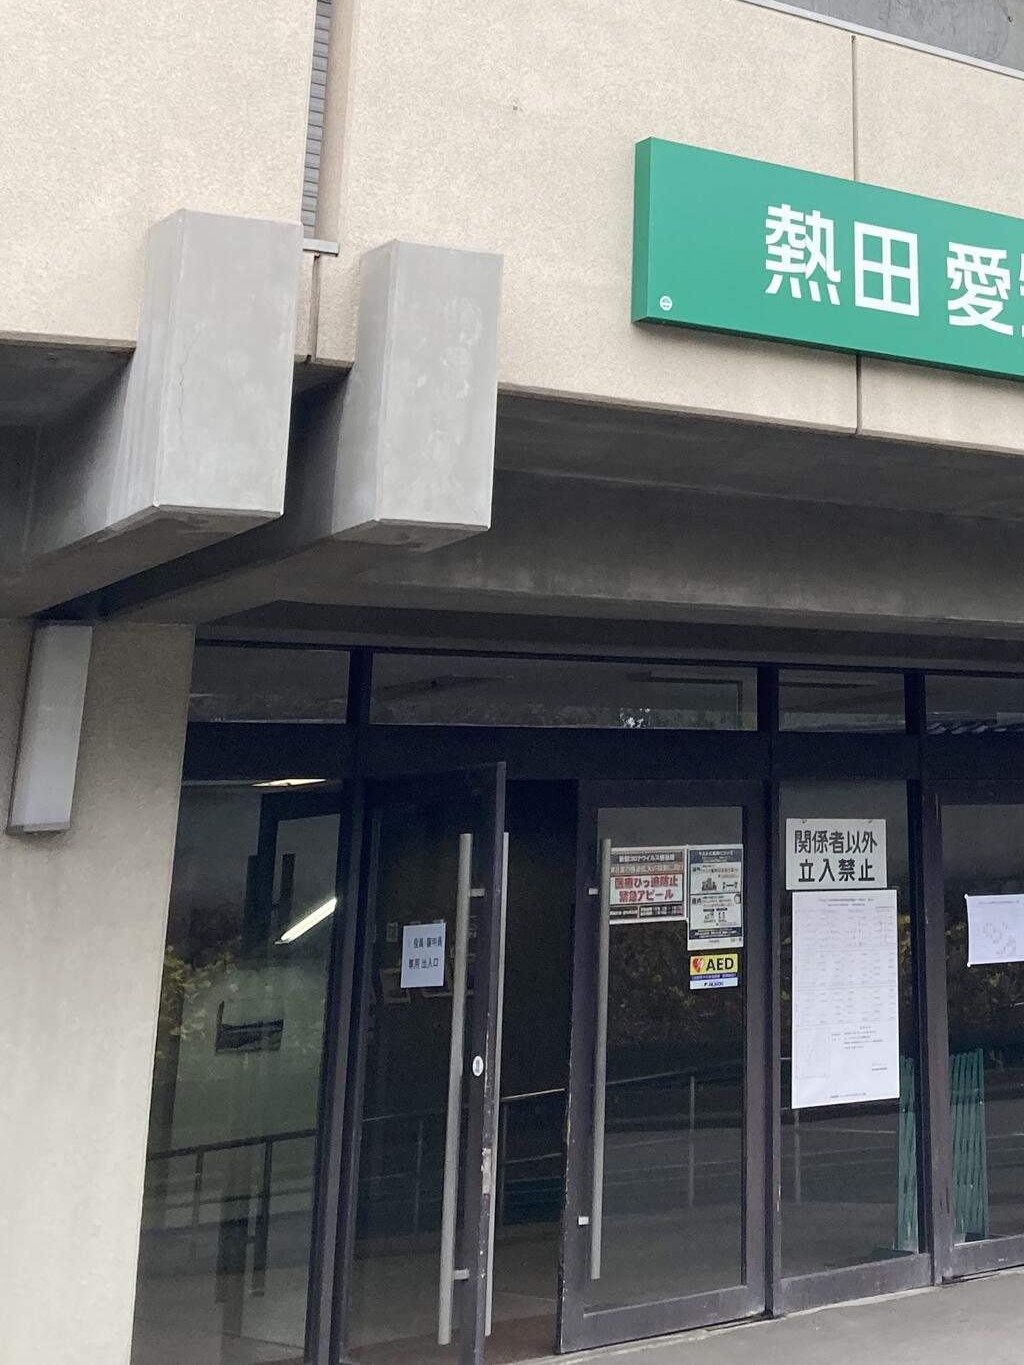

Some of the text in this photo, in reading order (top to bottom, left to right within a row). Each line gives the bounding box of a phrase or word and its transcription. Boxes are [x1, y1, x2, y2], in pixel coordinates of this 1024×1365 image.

[765, 204, 919, 317] 熱田
[794, 830, 878, 854] 関係者以外
[798, 858, 876, 882] 立入禁止
[619, 889, 674, 902] 緊急アピール
[706, 957, 734, 971] AED
